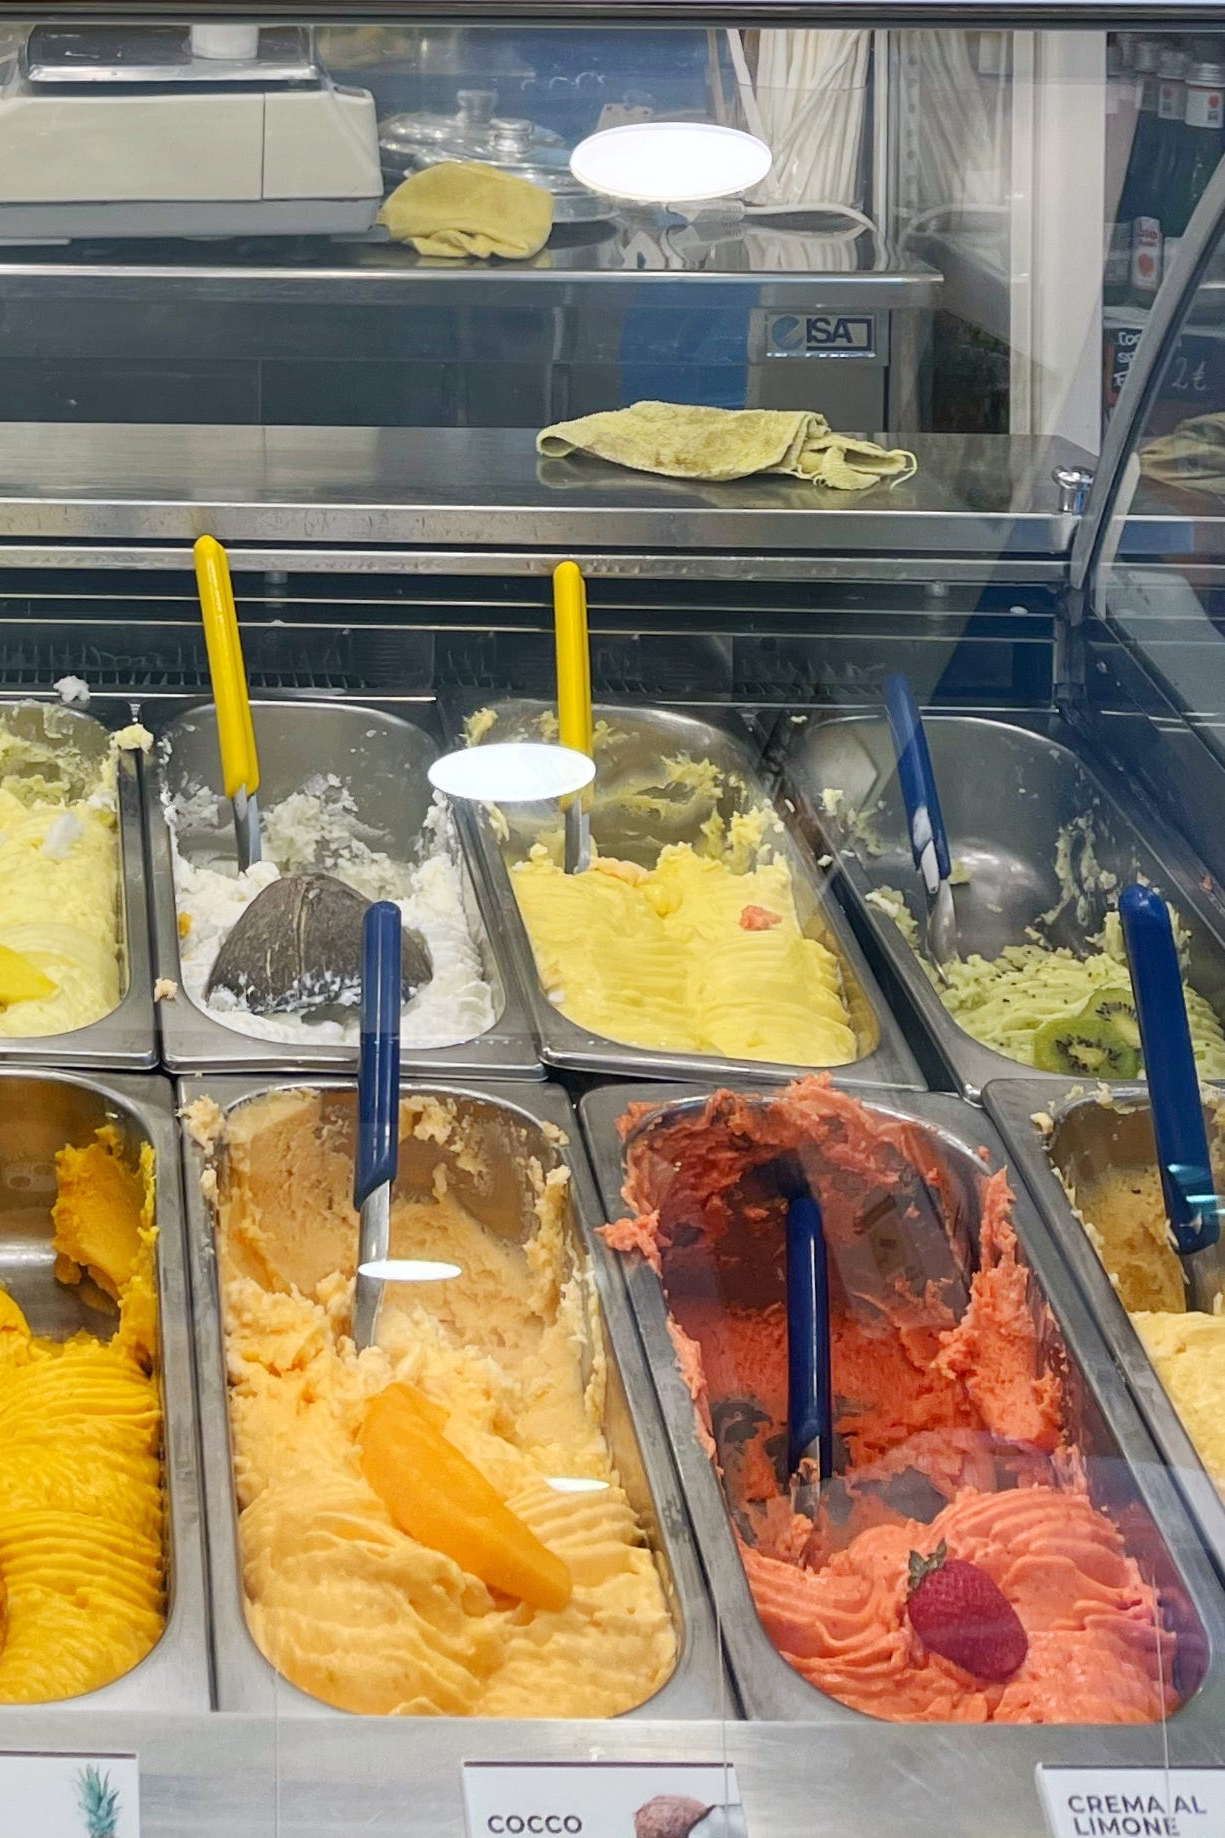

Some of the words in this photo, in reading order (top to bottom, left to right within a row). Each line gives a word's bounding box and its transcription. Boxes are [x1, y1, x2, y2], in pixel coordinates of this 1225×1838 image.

[806, 317, 854, 344] ISA
[1068, 1795, 1166, 1815] CREMA
[1174, 1795, 1208, 1815] AL
[487, 1814, 583, 1834] COCCO
[1073, 1816, 1181, 1837] LIMONE
